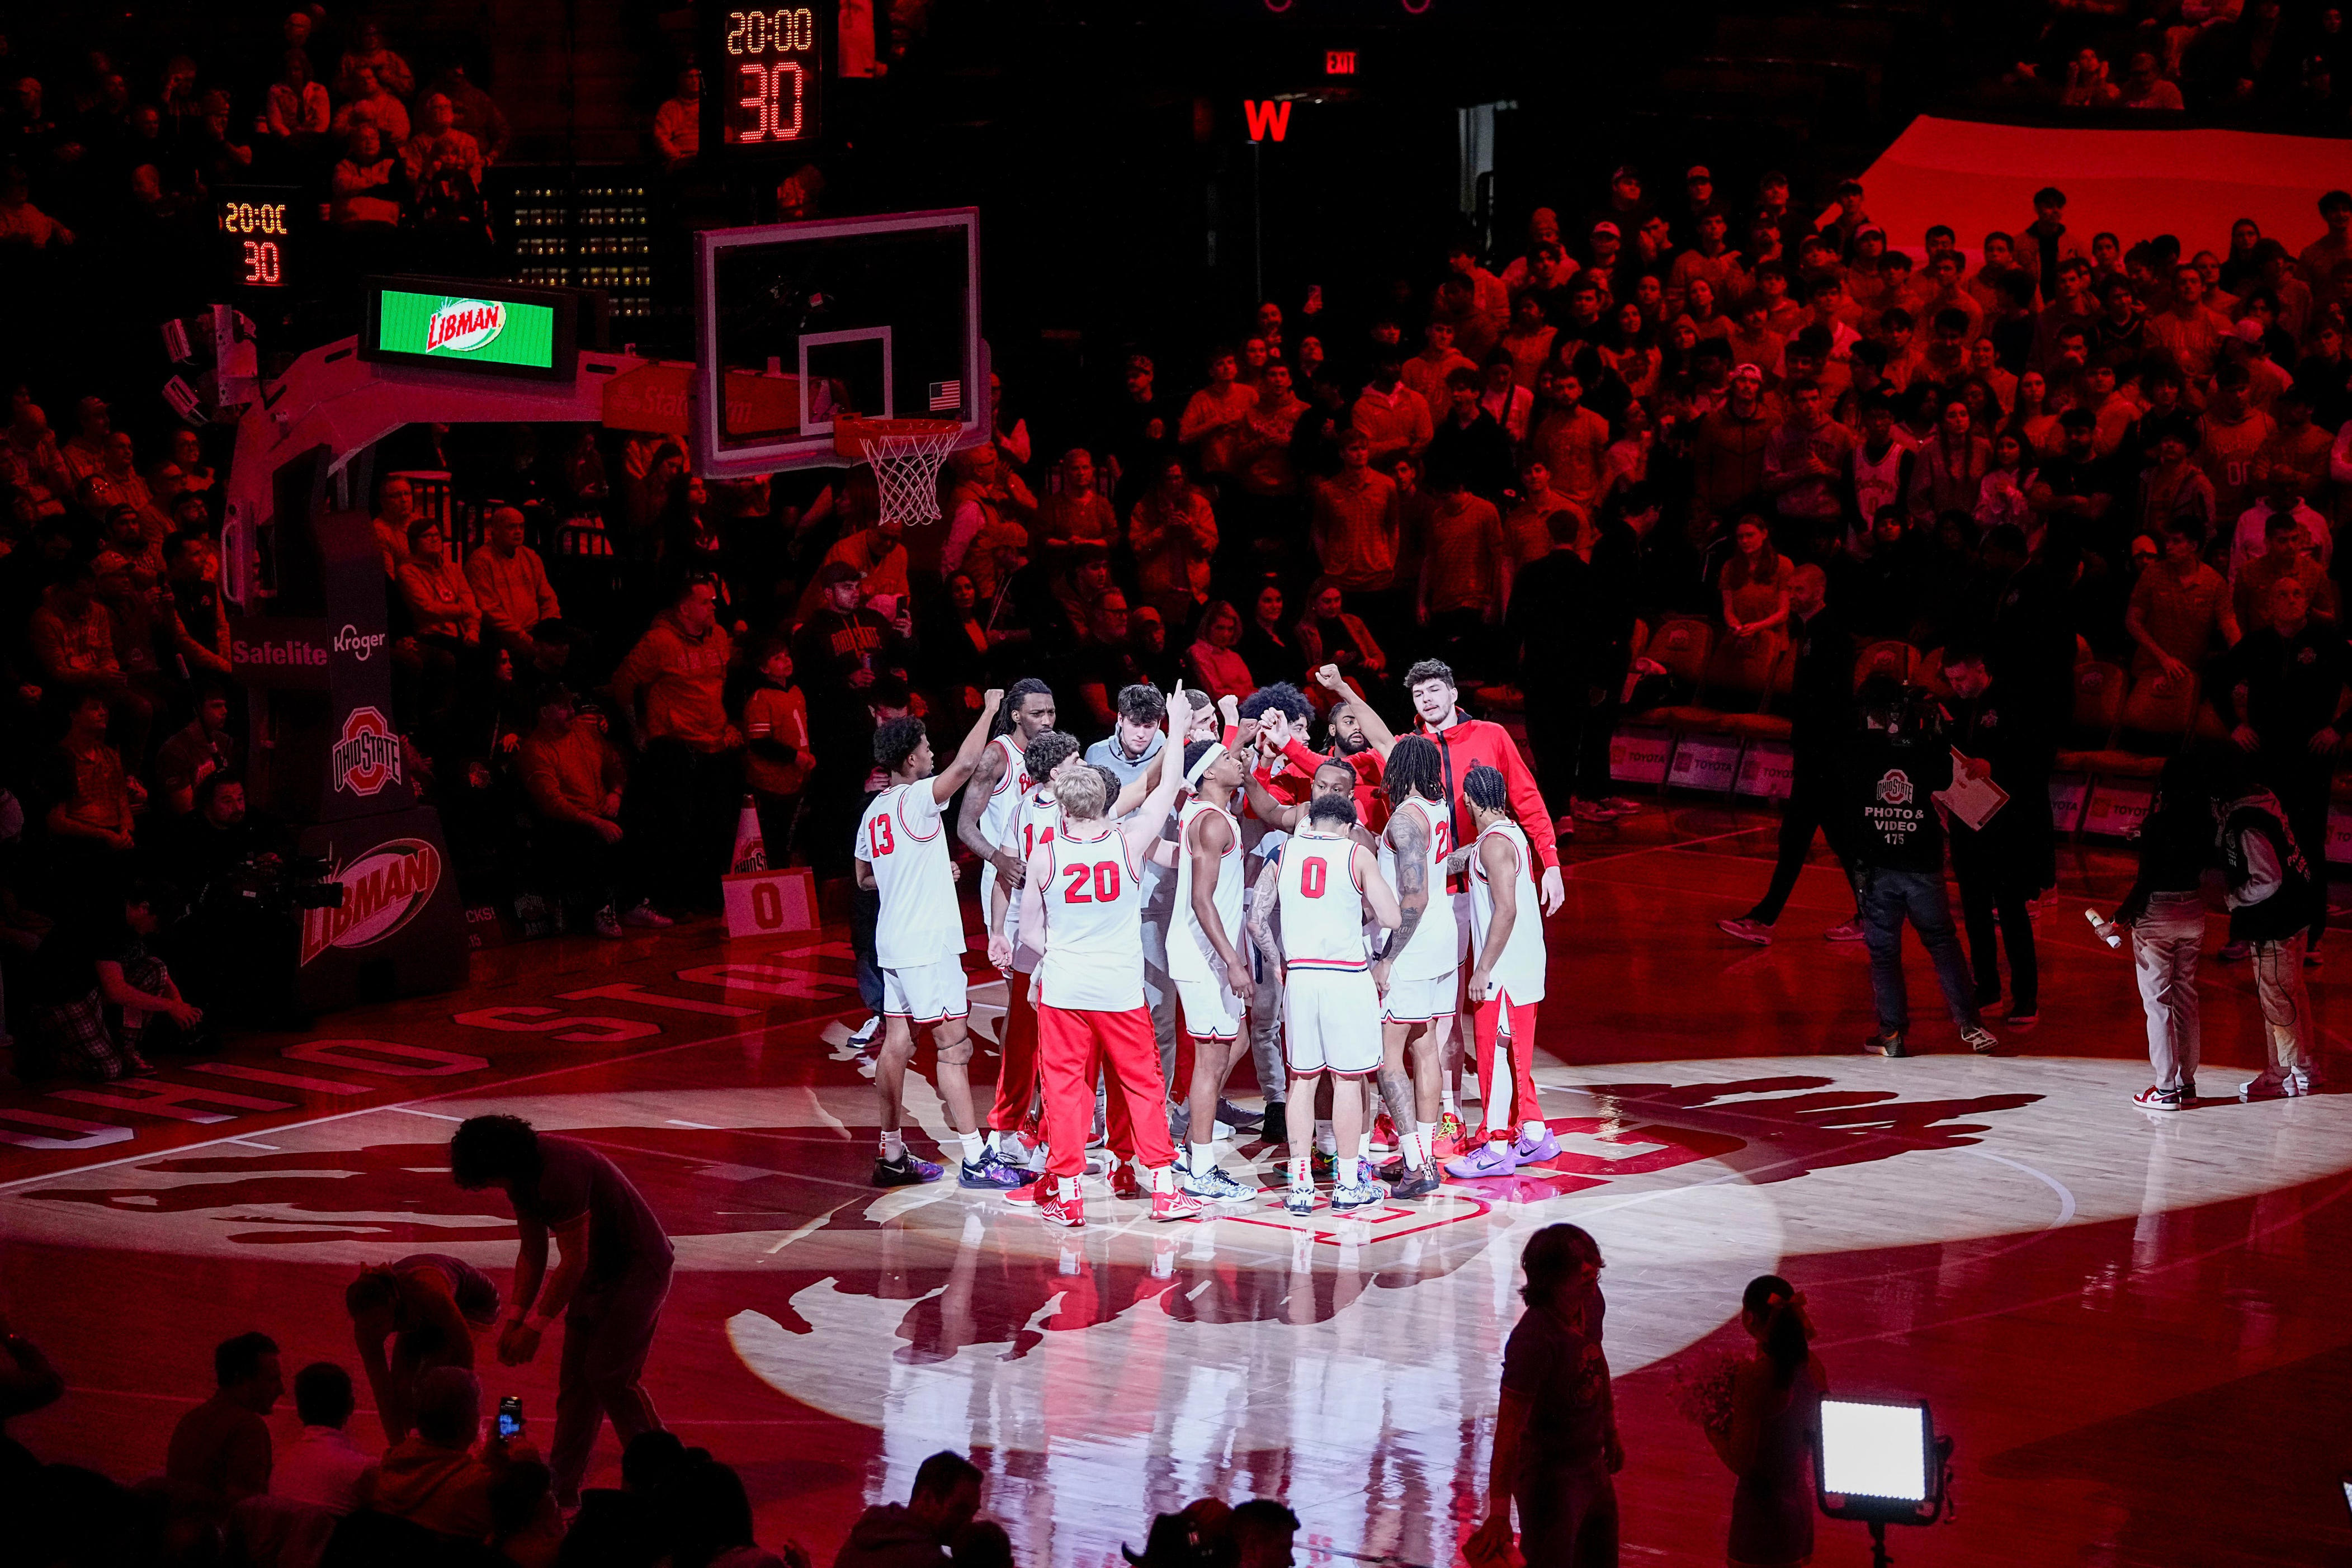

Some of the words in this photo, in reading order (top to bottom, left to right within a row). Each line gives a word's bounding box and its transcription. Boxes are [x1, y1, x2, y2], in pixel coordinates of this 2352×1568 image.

[727, 8, 813, 54] 20:00
[1326, 51, 1356, 74] EXIT
[740, 61, 803, 142] 30
[1243, 100, 1293, 142] W
[242, 240, 280, 284] 30
[427, 305, 499, 351] LIBMAN
[232, 640, 328, 666] Safelite
[334, 624, 386, 662] Kroger
[334, 738, 362, 791] OHIO
[361, 731, 400, 783] STATE
[1630, 752, 1664, 762] TOYOTA
[1694, 759, 1732, 772] TOYOTA
[1763, 768, 1795, 778] TOYO
[1877, 780, 1892, 800] OHIO
[1892, 778, 1913, 804] STATE
[2053, 800, 2077, 810] YOTA
[1864, 806, 1914, 819] PHOTO
[1915, 809, 1924, 819] &
[1874, 820, 1918, 832] VIDEO
[868, 813, 895, 858] 13
[1884, 833, 1905, 845] 175
[1063, 861, 1120, 904] 20
[1300, 856, 1328, 899] 0
[301, 848, 429, 967] LIBMAN
[465, 906, 497, 923] CKS!
[751, 882, 783, 930] 0
[453, 939, 861, 1043] STA
